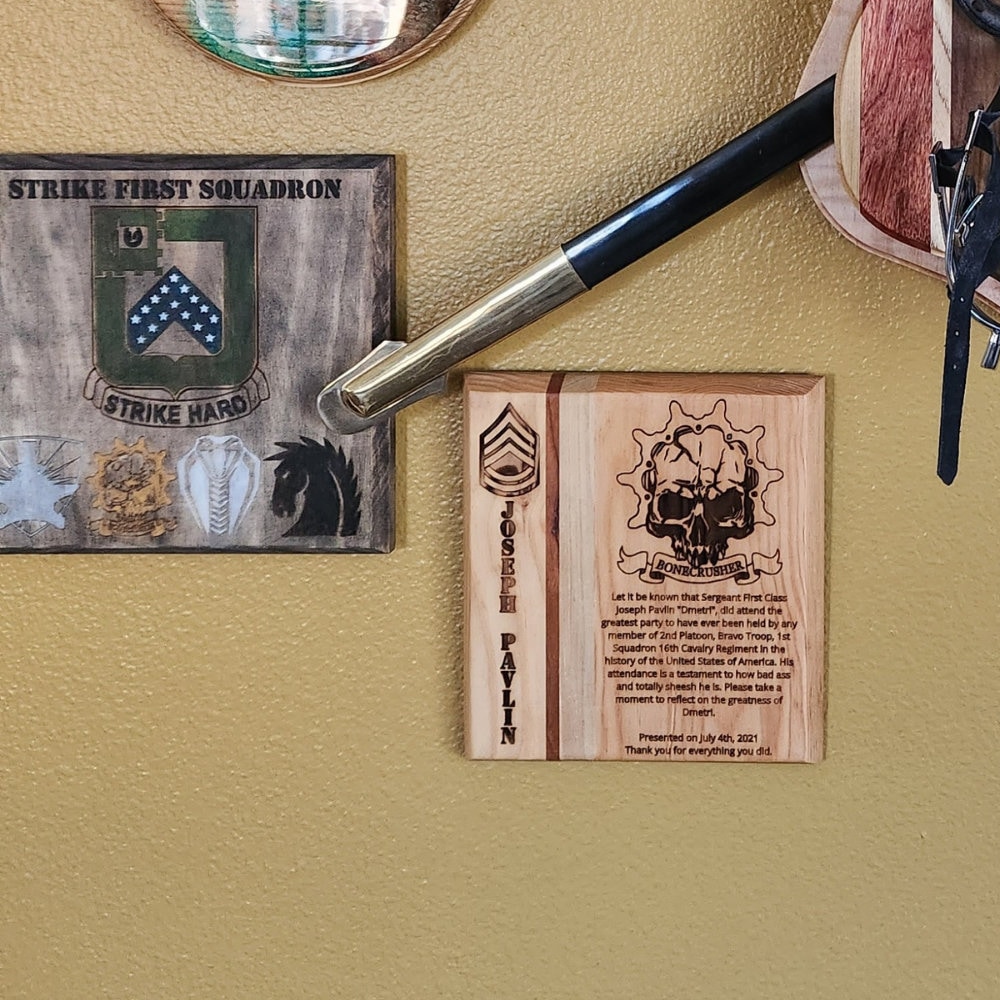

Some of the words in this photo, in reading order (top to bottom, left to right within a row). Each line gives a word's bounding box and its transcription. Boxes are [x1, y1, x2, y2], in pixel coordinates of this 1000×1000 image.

[8, 178, 106, 200] STRIKE
[114, 178, 191, 200] FIRST
[198, 178, 342, 200] SQUADRON
[103, 395, 181, 425] STRIKE
[189, 395, 247, 423] HARD
[499, 501, 517, 614] JOSEPH
[655, 559, 744, 577] BONECRUSHER
[612, 593, 625, 601] Let
[636, 593, 647, 601] be
[649, 593, 679, 601] known
[681, 593, 699, 601] that
[702, 593, 741, 603] Sergeant
[743, 593, 762, 601] First
[764, 593, 787, 601] Class
[615, 606, 646, 615] Joseph
[648, 606, 675, 615] Pavlin
[720, 606, 734, 615] did
[736, 606, 765, 615] attend
[768, 606, 782, 615] the
[601, 620, 638, 629] greatest
[640, 620, 663, 629] party
[665, 619, 674, 627] to
[677, 619, 698, 627] have
[722, 619, 745, 627] been
[747, 619, 766, 627] held
[768, 619, 779, 629] by
[781, 621, 797, 629] any
[608, 631, 645, 640] member
[649, 631, 658, 640] of
[660, 631, 677, 640] 2nd
[679, 631, 716, 641] Platoon,
[718, 631, 744, 640] Bravo
[745, 631, 774, 641] Troop,
[777, 631, 791, 640] 1st
[613, 644, 656, 654] Squadron
[659, 644, 679, 653] 16th
[681, 644, 714, 654] Cavalry
[716, 644, 758, 654] Regiment
[771, 644, 785, 653] the
[605, 657, 635, 667] history
[638, 657, 648, 665] of
[649, 657, 664, 665] the
[666, 657, 695, 665] United
[697, 657, 725, 665] States
[727, 657, 737, 665] of
[738, 657, 777, 665] America.
[780, 657, 794, 665] His
[607, 670, 657, 678] attendance
[676, 670, 722, 678] testament
[724, 670, 734, 678] to
[736, 670, 755, 678] how
[757, 670, 773, 678] bad
[499, 632, 517, 746] PAVLIN
[616, 682, 633, 691] and
[636, 682, 663, 692] totally
[665, 682, 696, 691] sheesh
[699, 682, 710, 691] he
[724, 682, 753, 691] Please
[755, 682, 774, 691] take
[615, 695, 654, 704] moment
[655, 695, 665, 704] to
[667, 695, 695, 704] reflect
[711, 695, 726, 704] the
[728, 695, 771, 706] greatness
[773, 695, 783, 704] of
[639, 733, 684, 742] Presented
[699, 733, 717, 744] July
[718, 733, 735, 744] 4th,
[737, 733, 758, 742] 2021
[625, 746, 652, 755] Thank
[654, 748, 671, 757] you
[673, 746, 685, 755] for
[688, 746, 735, 757] everything
[737, 748, 754, 757] you
